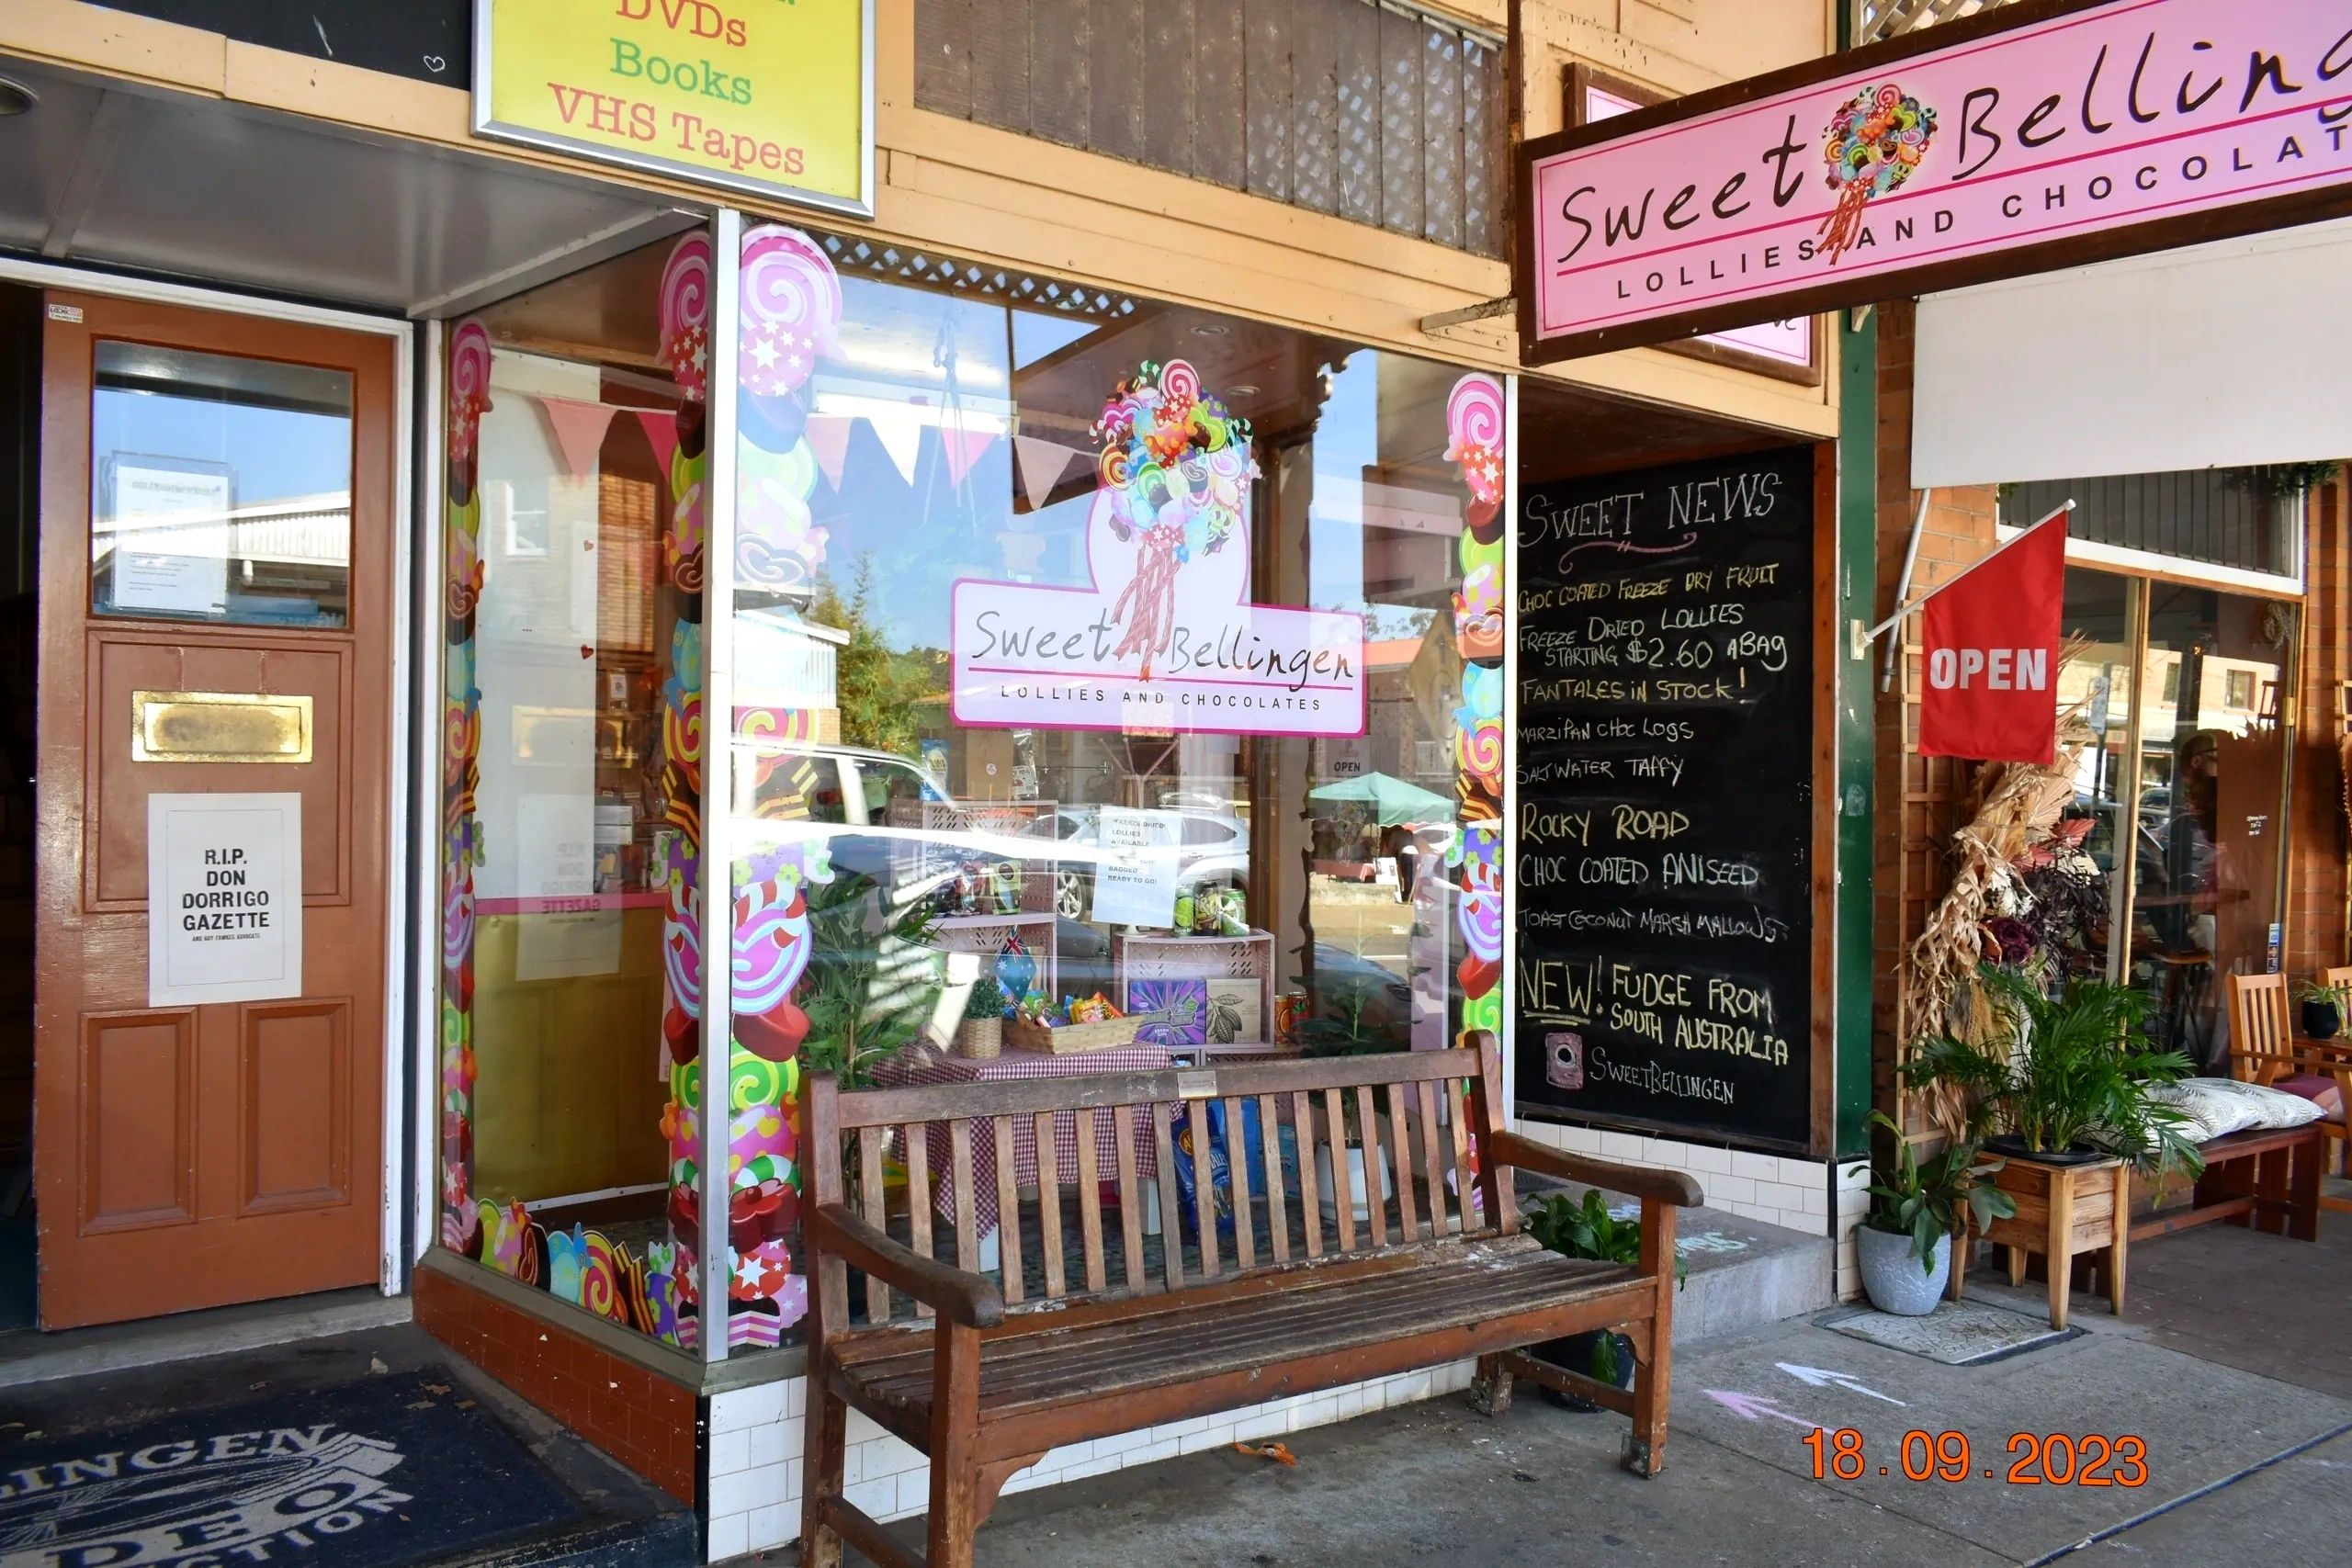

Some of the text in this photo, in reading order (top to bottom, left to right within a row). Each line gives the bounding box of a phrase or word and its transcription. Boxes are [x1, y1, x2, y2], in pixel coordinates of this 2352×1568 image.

[616, 0, 747, 47] DVDs
[609, 37, 752, 106] Books
[547, 82, 805, 175] VHS Tapes
[1557, 113, 1808, 264] Sweet
[1617, 239, 1815, 299] LOLLIES
[1856, 209, 1954, 250] AND
[1517, 472, 1782, 548] SWEET NEWS
[1558, 581, 1611, 606] COATED
[1685, 570, 1713, 593] DRY
[1725, 563, 1779, 590] FRUIT
[1588, 616, 1645, 643] DRIED
[1661, 603, 1745, 629] LOLLIES
[971, 607, 1354, 692] Sweet Bellingen
[1544, 645, 1619, 668] STARTING
[1625, 637, 1713, 669] $2.60
[1930, 648, 2047, 691] OPEN
[1001, 684, 1321, 711] LOLLIES AND CHOCOLATES
[1520, 678, 1625, 705] FANTALES
[1334, 761, 1361, 773] OPEN
[1521, 802, 1690, 847] ROCKY ROAD
[204, 848, 247, 865] R.I.P.
[205, 870, 246, 886] DON
[1519, 852, 1758, 889] CHOC COATED ANISEED
[182, 890, 269, 909] DORRIGO
[183, 912, 270, 931] GAZETTE
[1520, 954, 1773, 1024] NEW! FUDGE FROM
[1610, 1003, 1789, 1066] SOUTH AUSTRALIA
